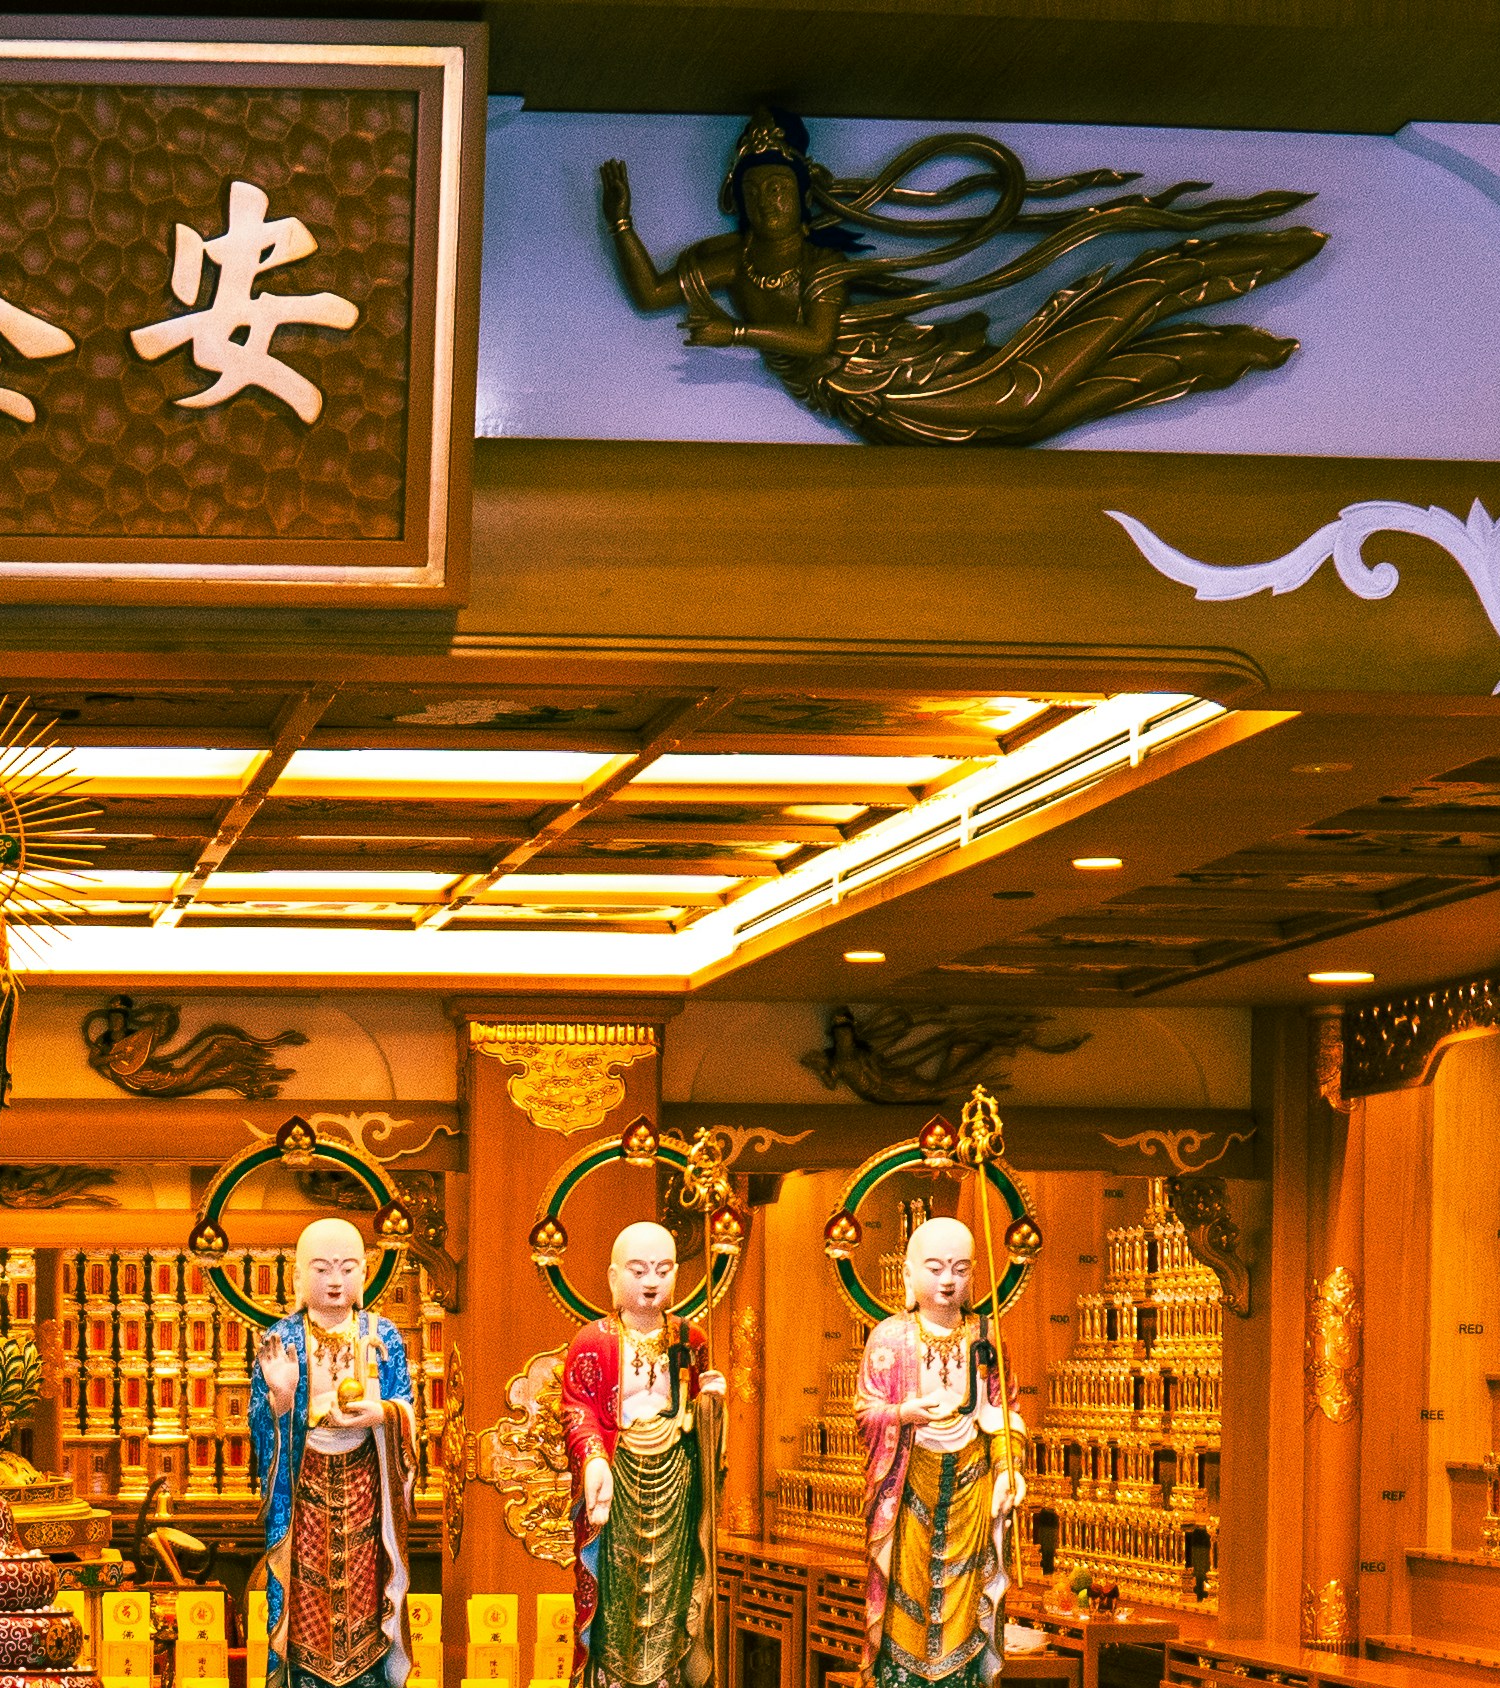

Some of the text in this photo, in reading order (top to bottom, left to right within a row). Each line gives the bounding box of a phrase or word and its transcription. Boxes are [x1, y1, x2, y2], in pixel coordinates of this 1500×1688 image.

[1459, 1324, 1483, 1334] RED
[1420, 1409, 1443, 1422] REE
[1382, 1491, 1405, 1501] REF
[1361, 1562, 1385, 1572] REG
[122, 1630, 134, 1640] 佛
